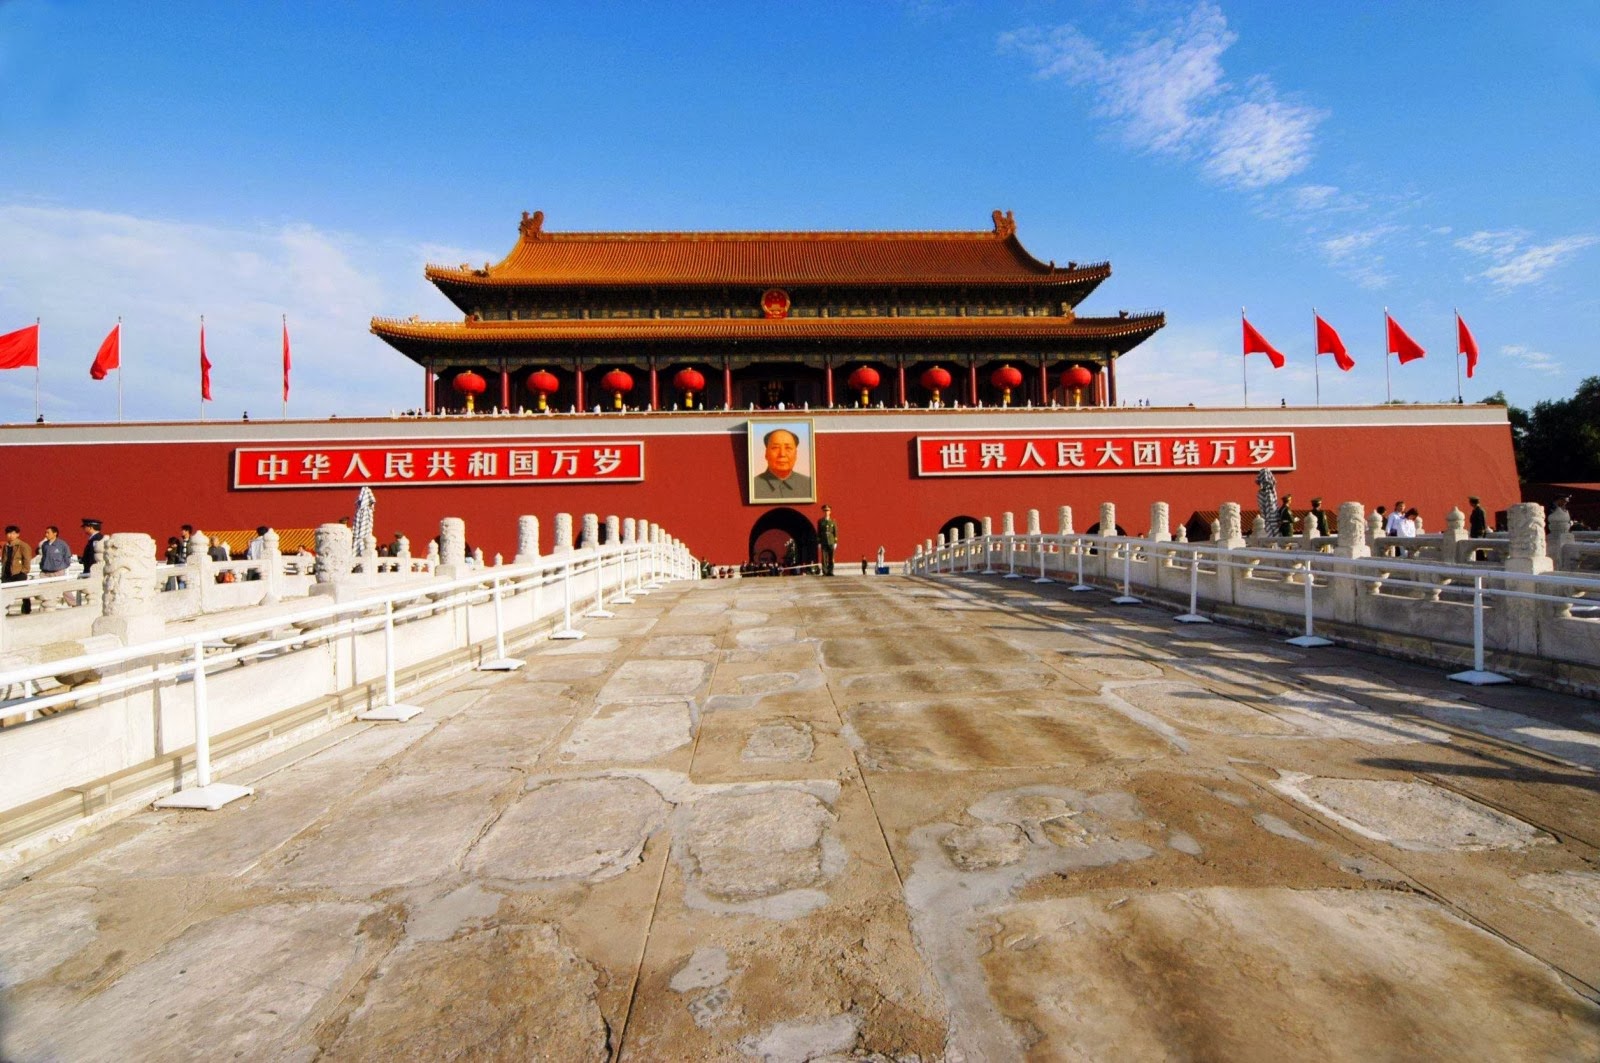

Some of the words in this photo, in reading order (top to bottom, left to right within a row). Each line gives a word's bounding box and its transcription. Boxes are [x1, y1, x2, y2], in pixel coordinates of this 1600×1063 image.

[257, 448, 622, 481] 中华人民共和国万岁
[939, 439, 1275, 469] 世界人民大团结万岁
